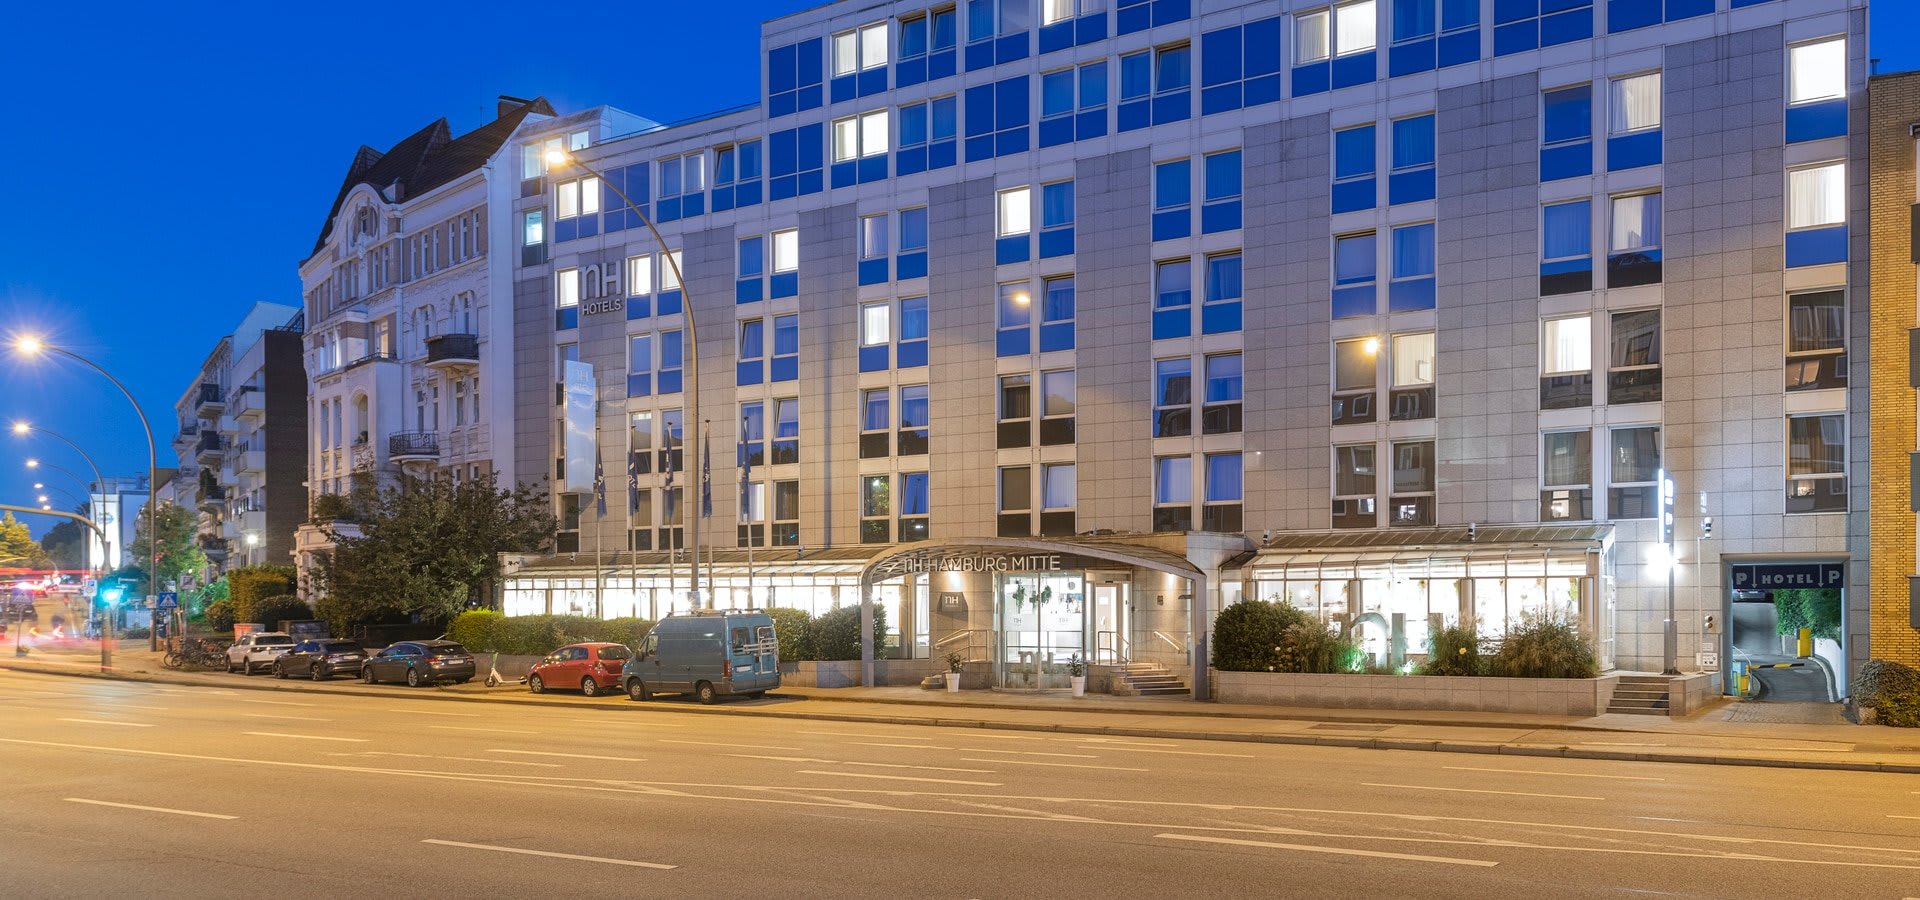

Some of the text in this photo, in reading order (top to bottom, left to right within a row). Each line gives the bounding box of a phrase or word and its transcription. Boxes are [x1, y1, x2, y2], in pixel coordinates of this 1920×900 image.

[582, 299, 622, 315] HOTELS
[927, 556, 1007, 572] HAMBURG
[1011, 555, 1061, 571] MITTE
[1736, 570, 1840, 585] P HOTEL P
